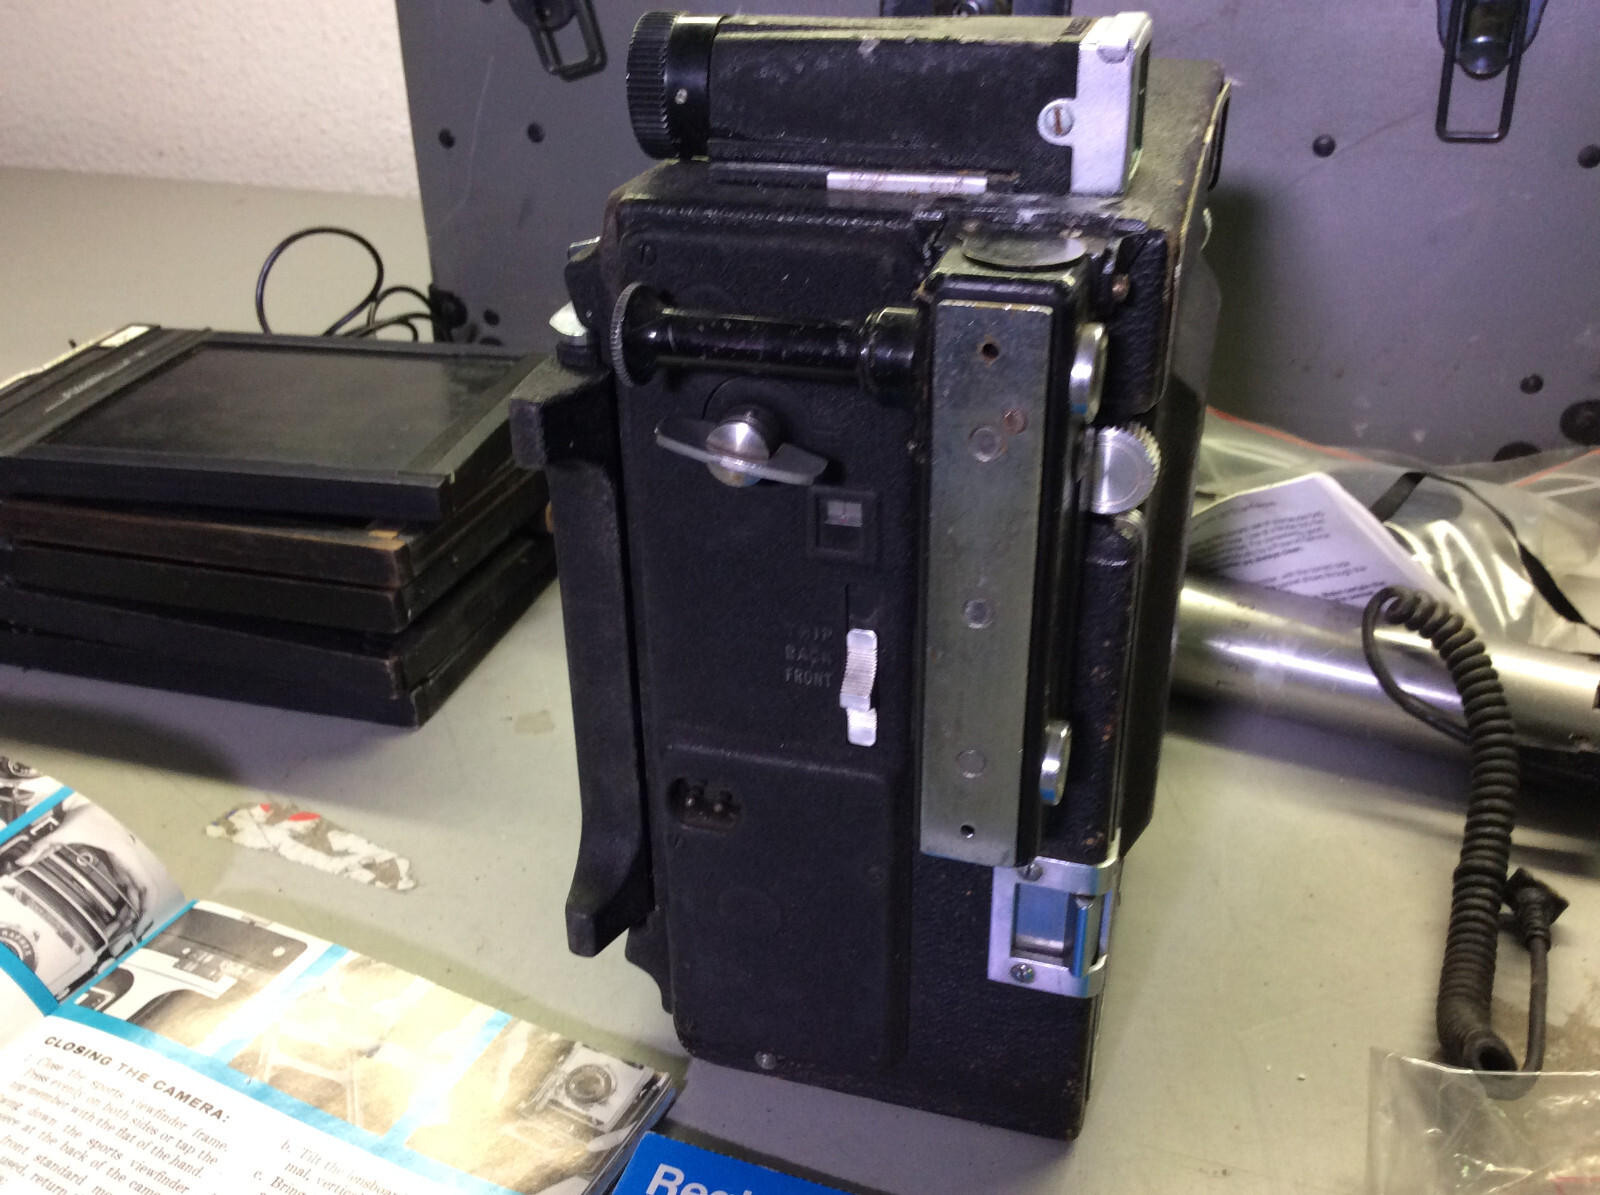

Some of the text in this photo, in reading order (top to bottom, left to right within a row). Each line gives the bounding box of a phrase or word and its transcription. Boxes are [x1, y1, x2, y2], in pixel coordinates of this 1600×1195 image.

[784, 666, 833, 689] FRONT
[44, 1035, 230, 1123] CLOSING THE CAMERA:
[37, 1130, 58, 1146] the
[59, 1140, 88, 1162] back
[90, 1158, 107, 1172] of
[105, 1166, 127, 1183] the
[63, 1123, 83, 1139] the
[87, 1138, 124, 1161] sports
[130, 1159, 190, 1194] viewfinder
[95, 1118, 116, 1132] the
[115, 1126, 137, 1143] flat
[136, 1140, 154, 1152] of
[150, 1145, 171, 1161] the
[168, 1154, 204, 1179] hand.
[131, 1116, 159, 1135] sides
[160, 1132, 174, 1144] or
[175, 1139, 196, 1156] tap
[197, 1149, 218, 1165] the
[33, 1153, 88, 1186] standard
